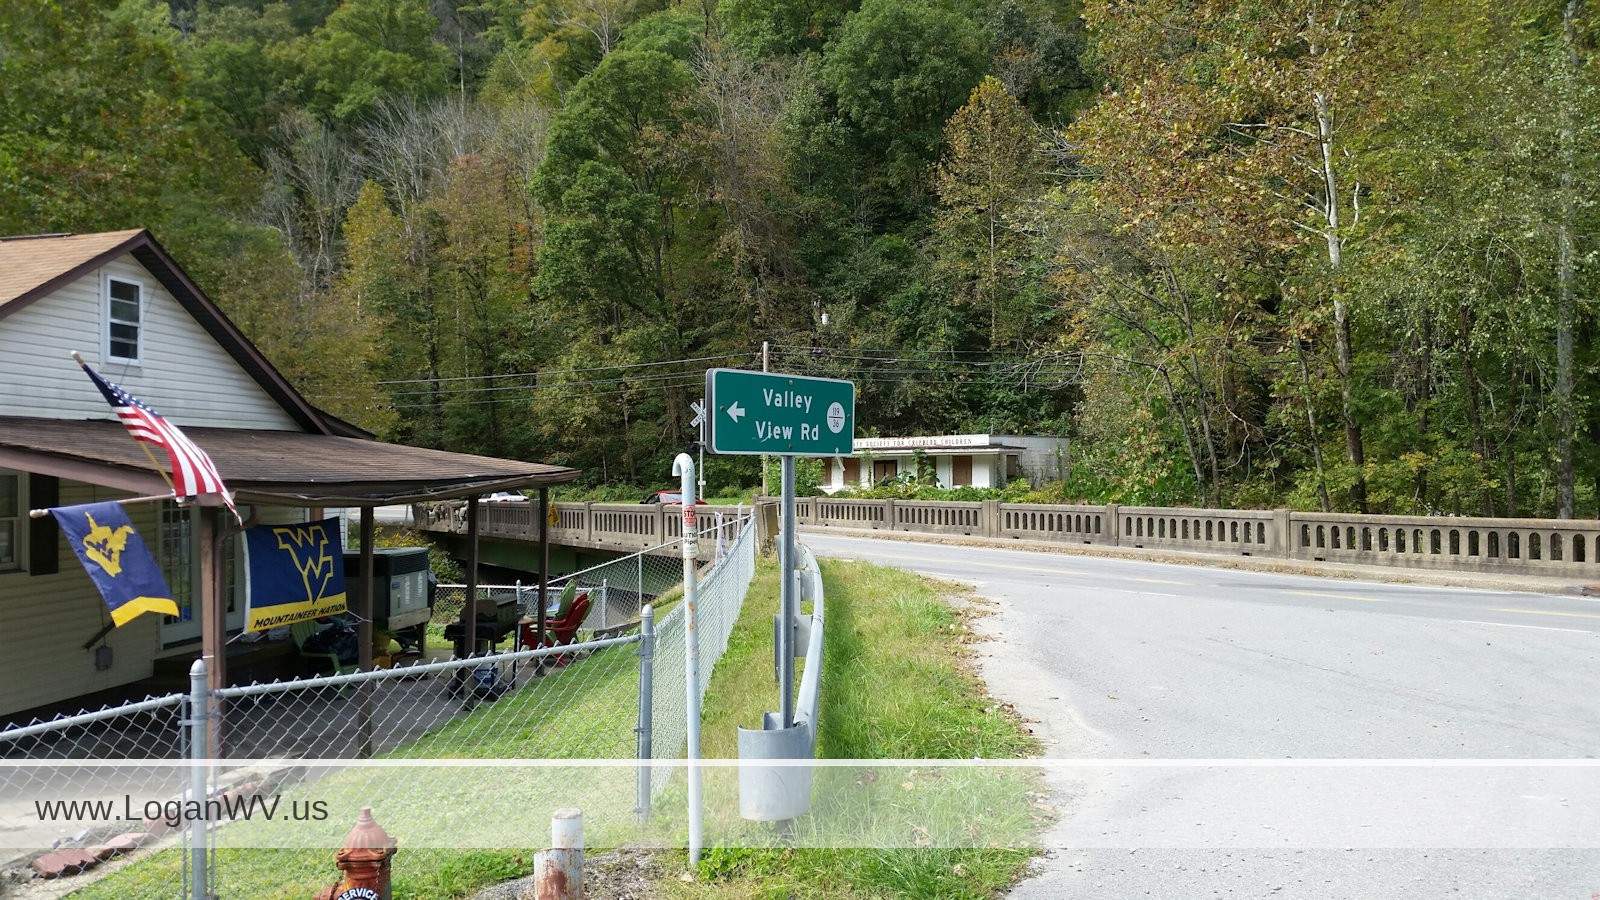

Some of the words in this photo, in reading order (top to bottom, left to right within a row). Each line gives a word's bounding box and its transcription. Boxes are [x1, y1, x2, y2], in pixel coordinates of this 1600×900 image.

[763, 388, 812, 413] Valley
[755, 421, 793, 440] View
[801, 423, 819, 441] Rd
[684, 510, 697, 518] STO
[253, 608, 318, 629] MOUNTAINEER
[318, 602, 346, 616] NATION
